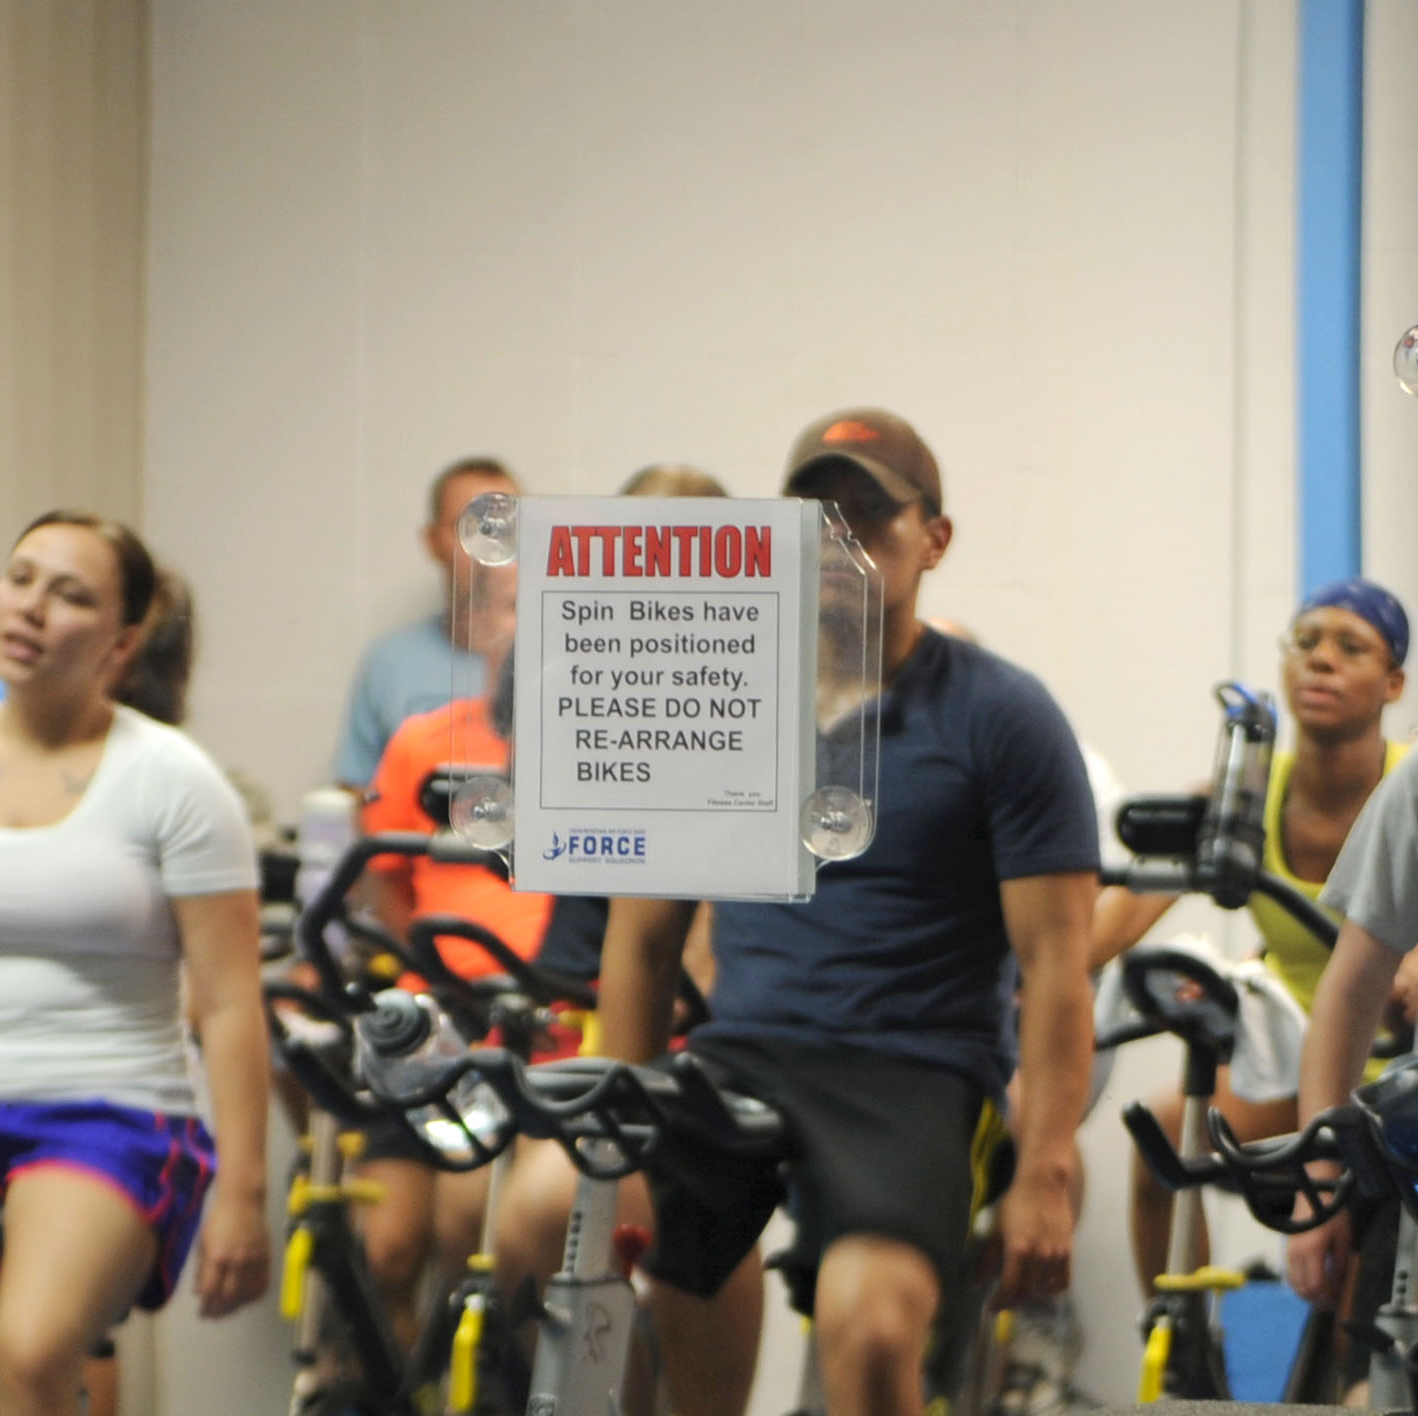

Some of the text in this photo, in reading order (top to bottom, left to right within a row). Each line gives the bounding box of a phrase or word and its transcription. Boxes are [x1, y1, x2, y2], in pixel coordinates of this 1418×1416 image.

[547, 525, 771, 578] ATTENTION
[561, 600, 759, 626] Spin Bikes have
[565, 632, 755, 659] been positioned
[570, 664, 748, 692] for your safety.
[559, 697, 762, 719] PLEASE DO NOT
[575, 730, 743, 751] RE-ARRANGE
[577, 762, 651, 783] BIKES
[569, 836, 646, 856] FORCE
